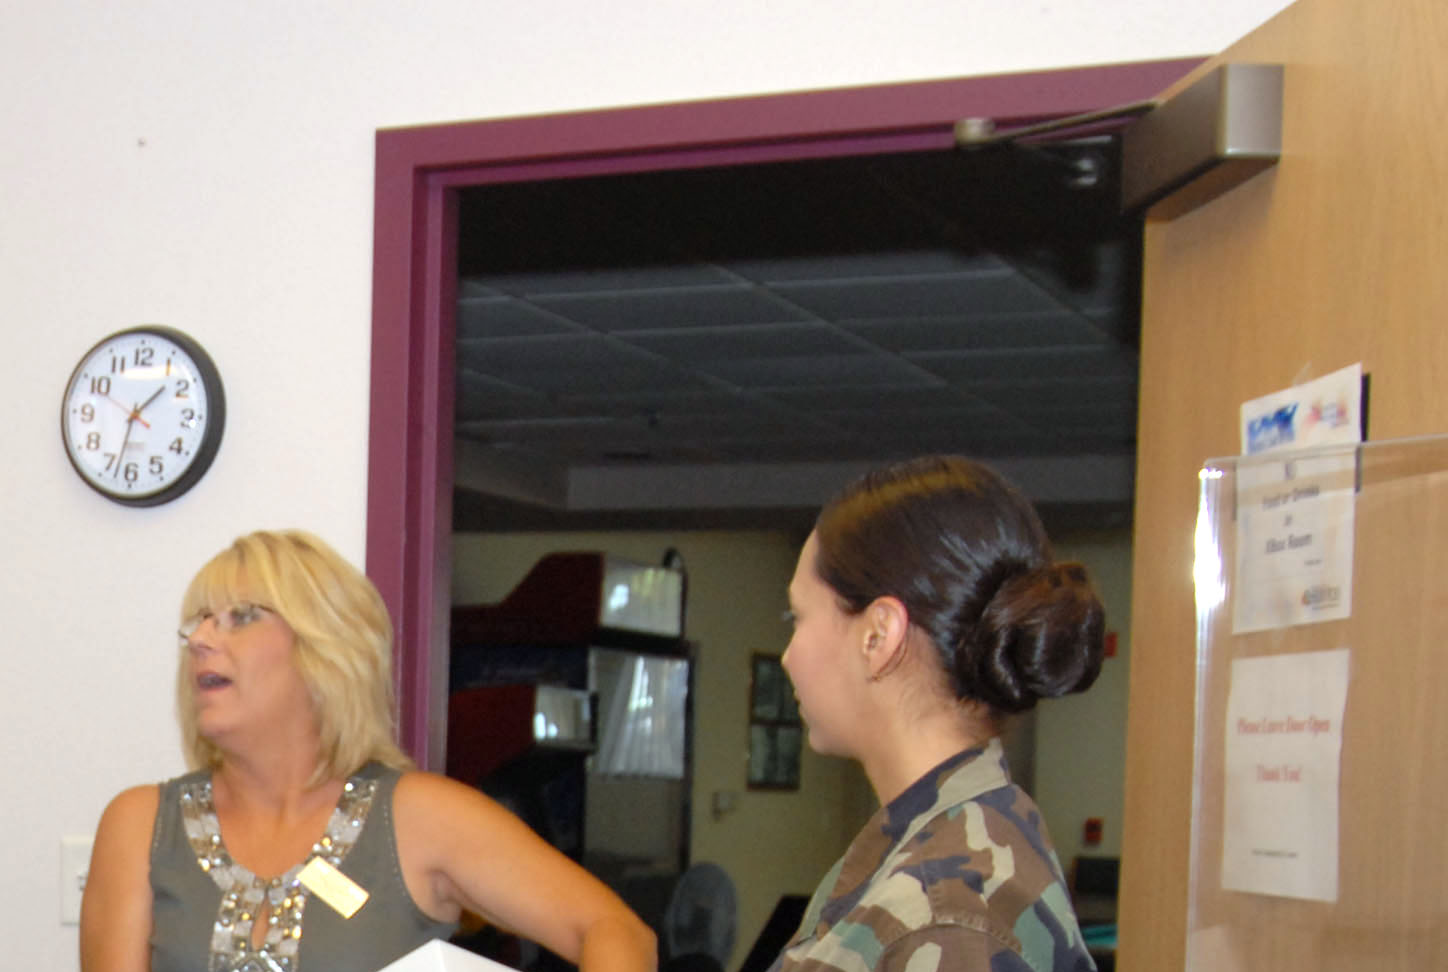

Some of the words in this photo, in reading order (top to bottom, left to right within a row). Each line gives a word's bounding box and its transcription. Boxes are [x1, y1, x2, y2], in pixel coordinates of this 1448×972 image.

[111, 354, 127, 374] 11
[133, 346, 155, 367] 12
[165, 356, 172, 377] 1
[90, 376, 112, 395] 10
[175, 378, 190, 399] 2
[80, 402, 95, 424] 9
[180, 407, 197, 429] 3
[85, 431, 101, 451] 8
[168, 437, 184, 456] 4
[103, 452, 117, 472] 7
[148, 455, 164, 475] 5
[123, 462, 139, 483] 6
